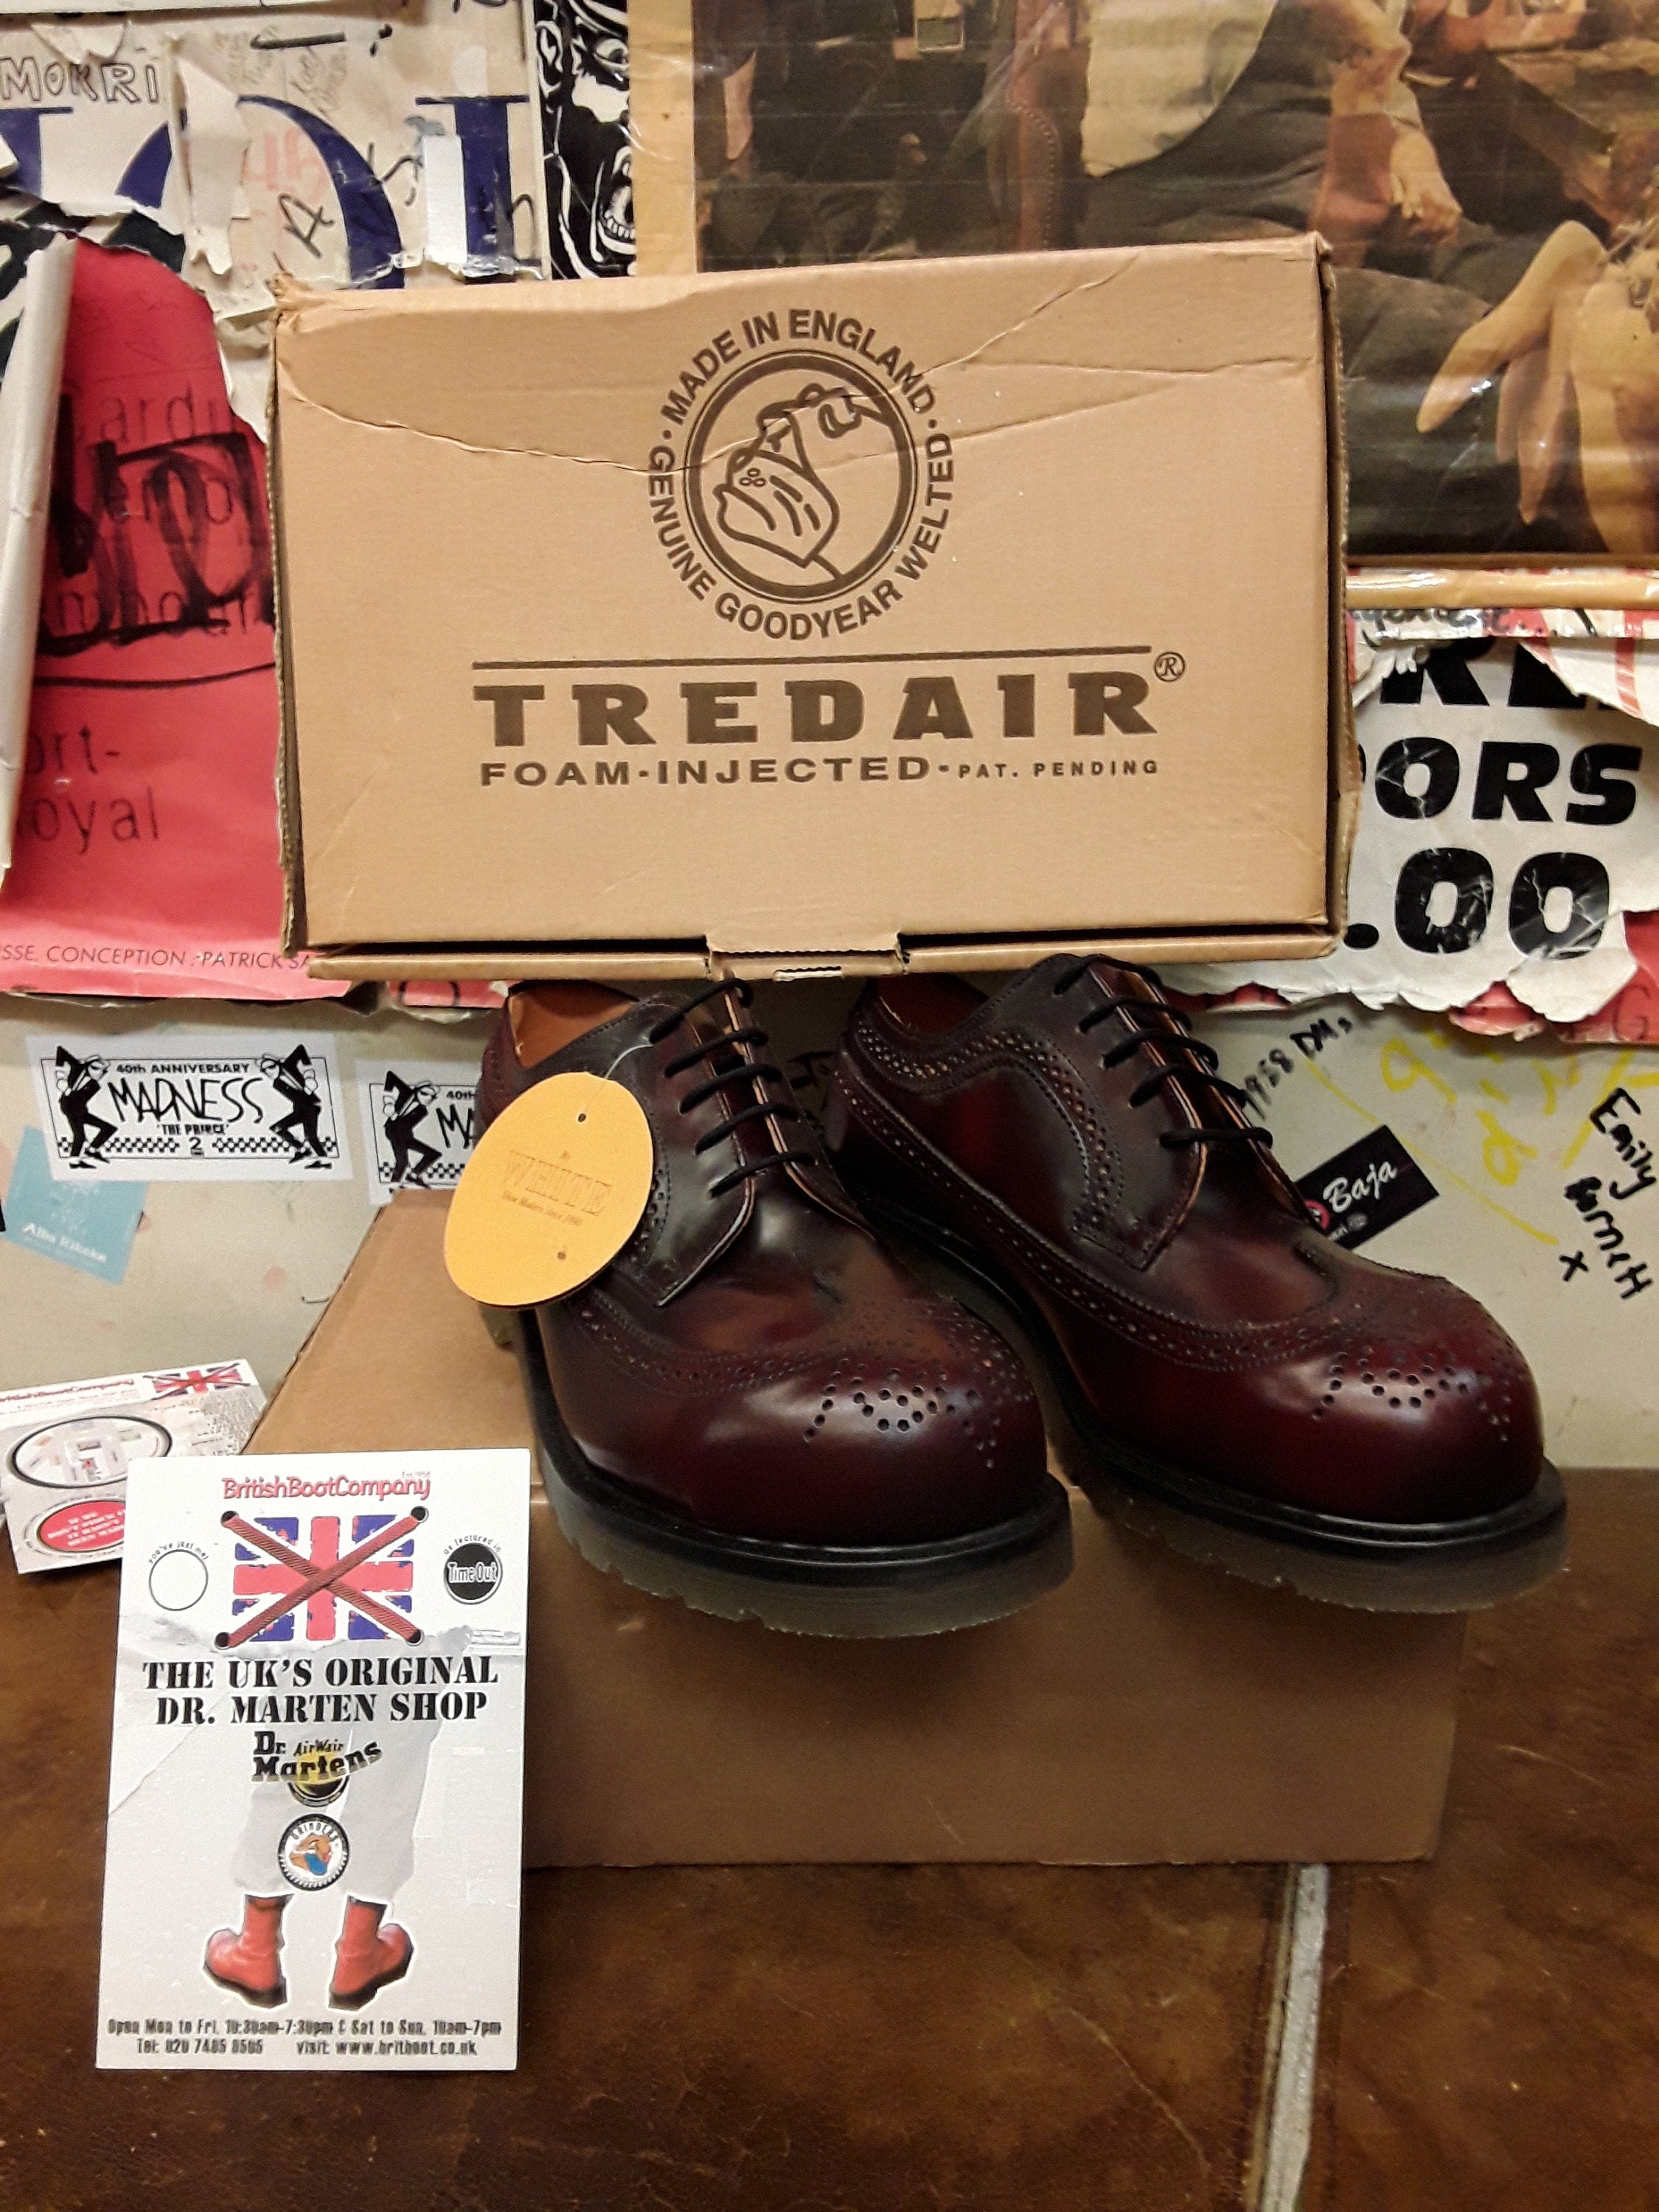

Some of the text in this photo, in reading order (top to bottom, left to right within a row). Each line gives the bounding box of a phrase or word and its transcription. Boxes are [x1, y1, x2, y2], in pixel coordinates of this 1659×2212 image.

[661, 308, 936, 425] MADE IN ENGLAND
[648, 432, 954, 641] GENUINE GOODYEAR WELTED
[473, 670, 1158, 746] TREDAIR
[1033, 759, 1159, 778] PENDING
[1357, 736, 1644, 826] ORS
[1343, 847, 1611, 960] .00
[46, 945, 186, 966] CONCEPTION
[116, 1062, 250, 1074] 40th ANNIVERSARY
[108, 1077, 264, 1124] MADNESS
[446, 1091, 476, 1101] 40t
[1589, 1087, 1657, 1200] Emily
[1322, 1161, 1399, 1214] Baja
[221, 1474, 431, 1501] BritishBootCompany
[142, 1654, 500, 1690] THE UK'S ORIGINAL
[156, 1691, 488, 1725] DR. MARTEN SHOP
[251, 1741, 383, 1782] Martens
[108, 2018, 140, 2036] Open
[145, 2019, 173, 2035] Mon
[178, 2020, 192, 2034] to
[351, 2019, 374, 2035] Sat
[380, 2020, 394, 2034] to
